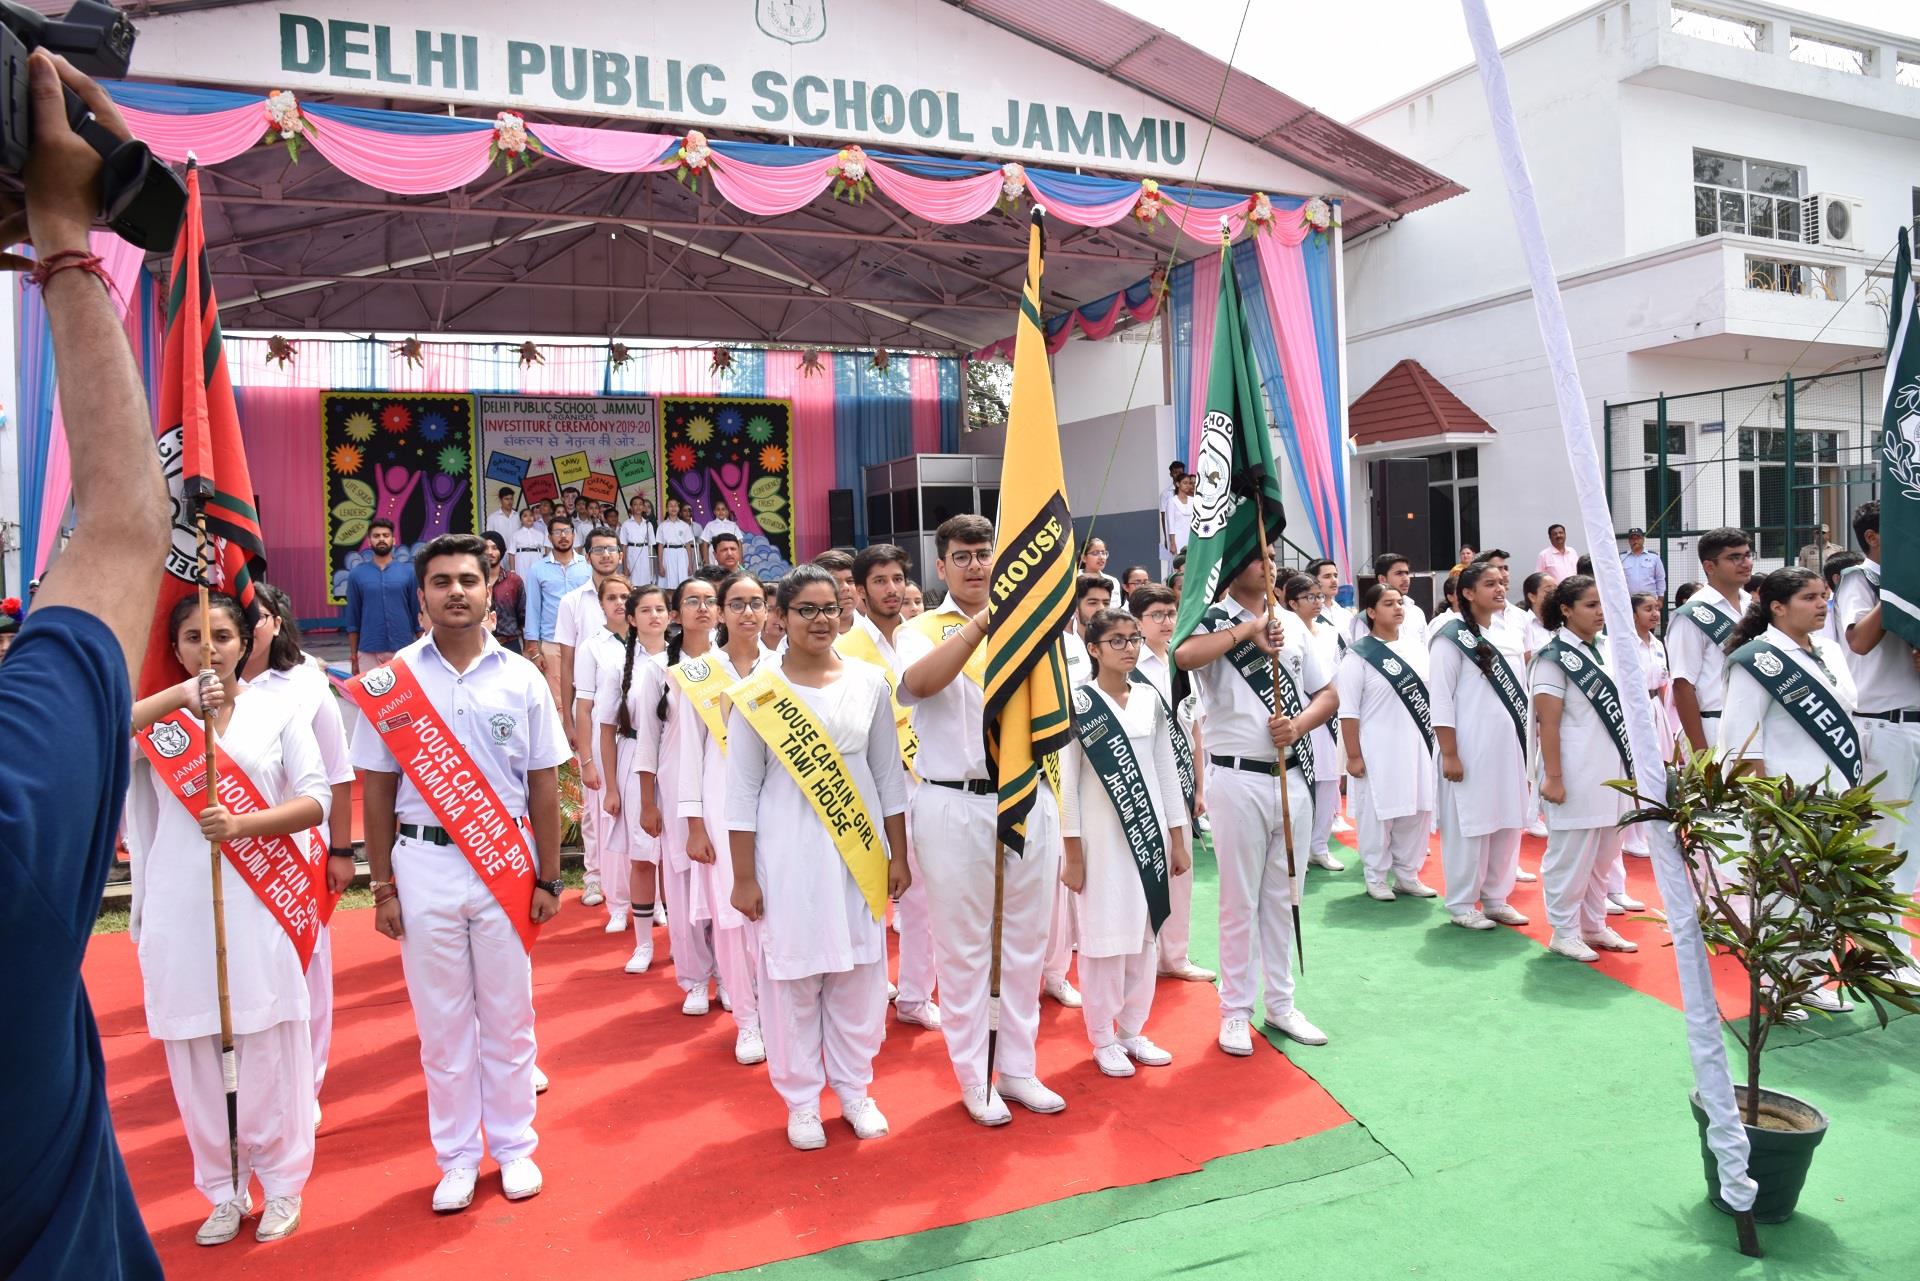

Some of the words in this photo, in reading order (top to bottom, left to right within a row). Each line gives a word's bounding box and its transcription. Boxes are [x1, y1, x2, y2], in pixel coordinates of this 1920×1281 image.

[279, 13, 478, 91] DELHI
[507, 40, 727, 116] PUBLIC
[751, 70, 974, 143] SCHOOL
[992, 99, 1186, 166] JAMMU
[484, 401, 510, 413] DELHI
[514, 401, 552, 413] PUBLIC
[554, 402, 598, 414] SCHOOL
[602, 402, 646, 415] JAMMU
[485, 420, 551, 432] INVESTITURE
[555, 420, 615, 432] CEREMONY
[616, 420, 651, 434] 2019-20
[561, 457, 580, 467] TAWI
[563, 466, 582, 475] HOUSE
[993, 516, 1063, 601] HOUSE
[1714, 620, 1731, 638] JAMMU
[1491, 662, 1518, 702] CULTURAL
[1579, 669, 1597, 686] JAMMU
[1776, 671, 1802, 695] JAMMU
[377, 690, 413, 719] JAMMU
[1408, 688, 1431, 723] SPORTS
[1598, 686, 1622, 723] VICE
[1799, 692, 1856, 759] HEAD
[173, 752, 207, 782] JAMM
[773, 697, 819, 748] HOUSE
[811, 749, 855, 807] CAPTAIN
[853, 811, 879, 851] GIRL
[1178, 765, 1192, 798] HOUSE
[1296, 740, 1315, 786] HOUSE
[412, 715, 461, 777] HOUSE
[452, 770, 508, 839] CAPTAIN
[506, 845, 530, 878] BOY
[780, 733, 817, 779] TAWI
[811, 778, 852, 837] HOUSE
[410, 749, 465, 822] YAMUNA
[460, 820, 506, 877] HOUSE
[1104, 772, 1135, 824] JHELUM
[1128, 825, 1151, 870] HOUSE
[1107, 734, 1139, 787] HOUSE
[1130, 782, 1157, 842] CAPTAIN
[1154, 848, 1165, 882] GIRL
[264, 878, 309, 936] HOUSE
